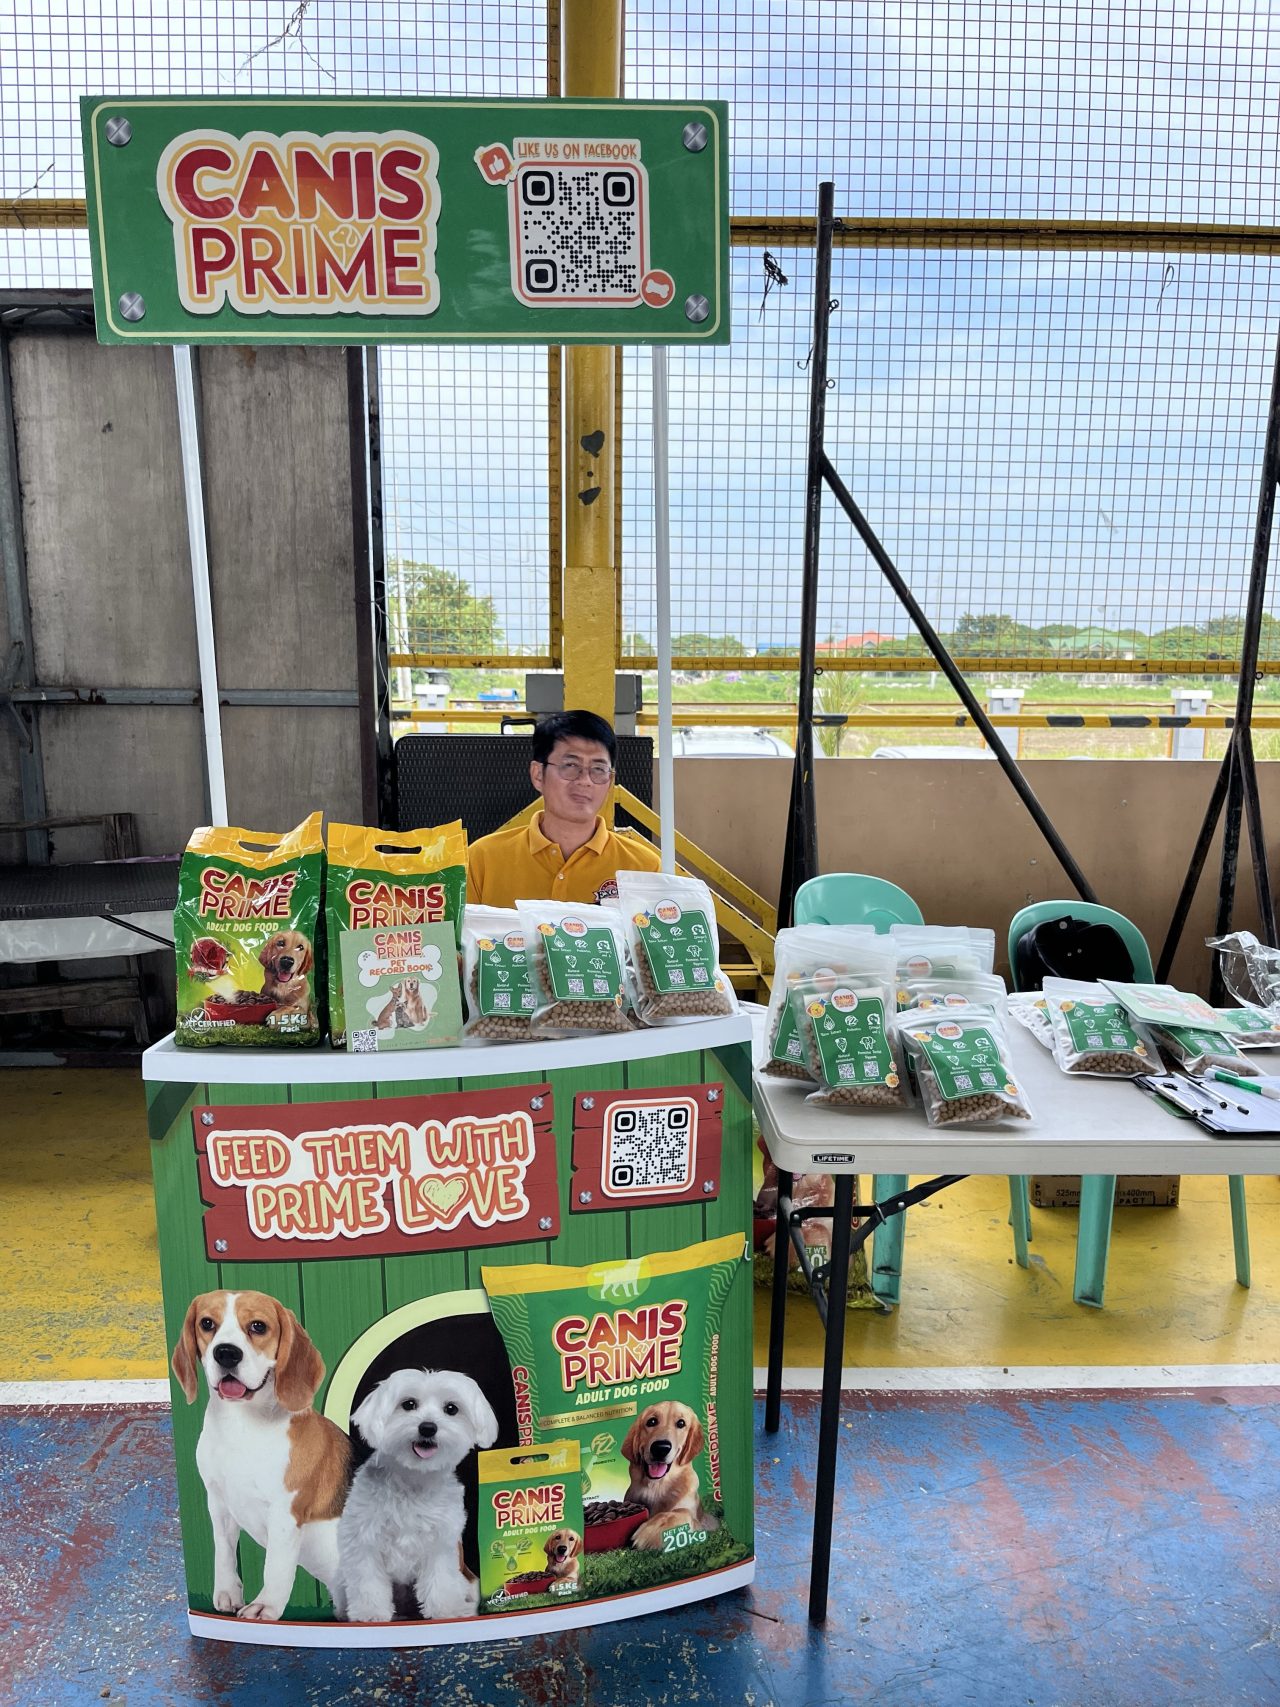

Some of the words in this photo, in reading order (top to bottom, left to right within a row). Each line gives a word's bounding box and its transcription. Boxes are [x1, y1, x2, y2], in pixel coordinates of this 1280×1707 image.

[518, 142, 540, 156] LIKE
[544, 143, 559, 156] US
[563, 143, 580, 157] ON
[584, 143, 637, 158] FACEBOOK
[173, 148, 427, 221] CANIS
[190, 226, 424, 297] PRIME
[203, 869, 296, 899] CANIS
[348, 881, 444, 910] CANIS
[201, 890, 289, 918] PRIME
[206, 921, 231, 932] ADULT
[233, 922, 252, 932] DOG
[254, 922, 279, 932] FOOD
[352, 907, 443, 930] PRIME
[375, 930, 421, 946] CANIS
[377, 944, 422, 959] PRIME
[369, 966, 405, 976] RECORD
[407, 964, 433, 973] BOOK
[390, 959, 407, 968] PET
[280, 1025, 300, 1033] Pack
[216, 1136, 288, 1176] FEED
[306, 1131, 409, 1175] THEM
[428, 1120, 526, 1167] WITH
[817, 1155, 849, 1163] LIFETIME
[256, 1180, 380, 1230] PRIME
[555, 1302, 685, 1353] CANIS
[711, 1333, 720, 1355] FOOD
[564, 1338, 679, 1388] PRIME
[710, 1355, 718, 1371] DOG
[512, 1366, 532, 1425] CANIS
[575, 1389, 612, 1406] ADULT
[613, 1385, 638, 1400] DOG
[640, 1378, 670, 1395] FOOD
[709, 1373, 717, 1397] ADULT
[543, 1416, 570, 1426] COMPLETE
[576, 1411, 604, 1421] BALANCED
[605, 1406, 633, 1417] NUTRITION
[493, 1485, 564, 1509] CANIS
[497, 1503, 562, 1528] PRIME
[503, 1528, 523, 1537] ADULT
[525, 1526, 538, 1534] DOG
[540, 1525, 557, 1533] FOOD
[663, 1528, 676, 1537] NET
